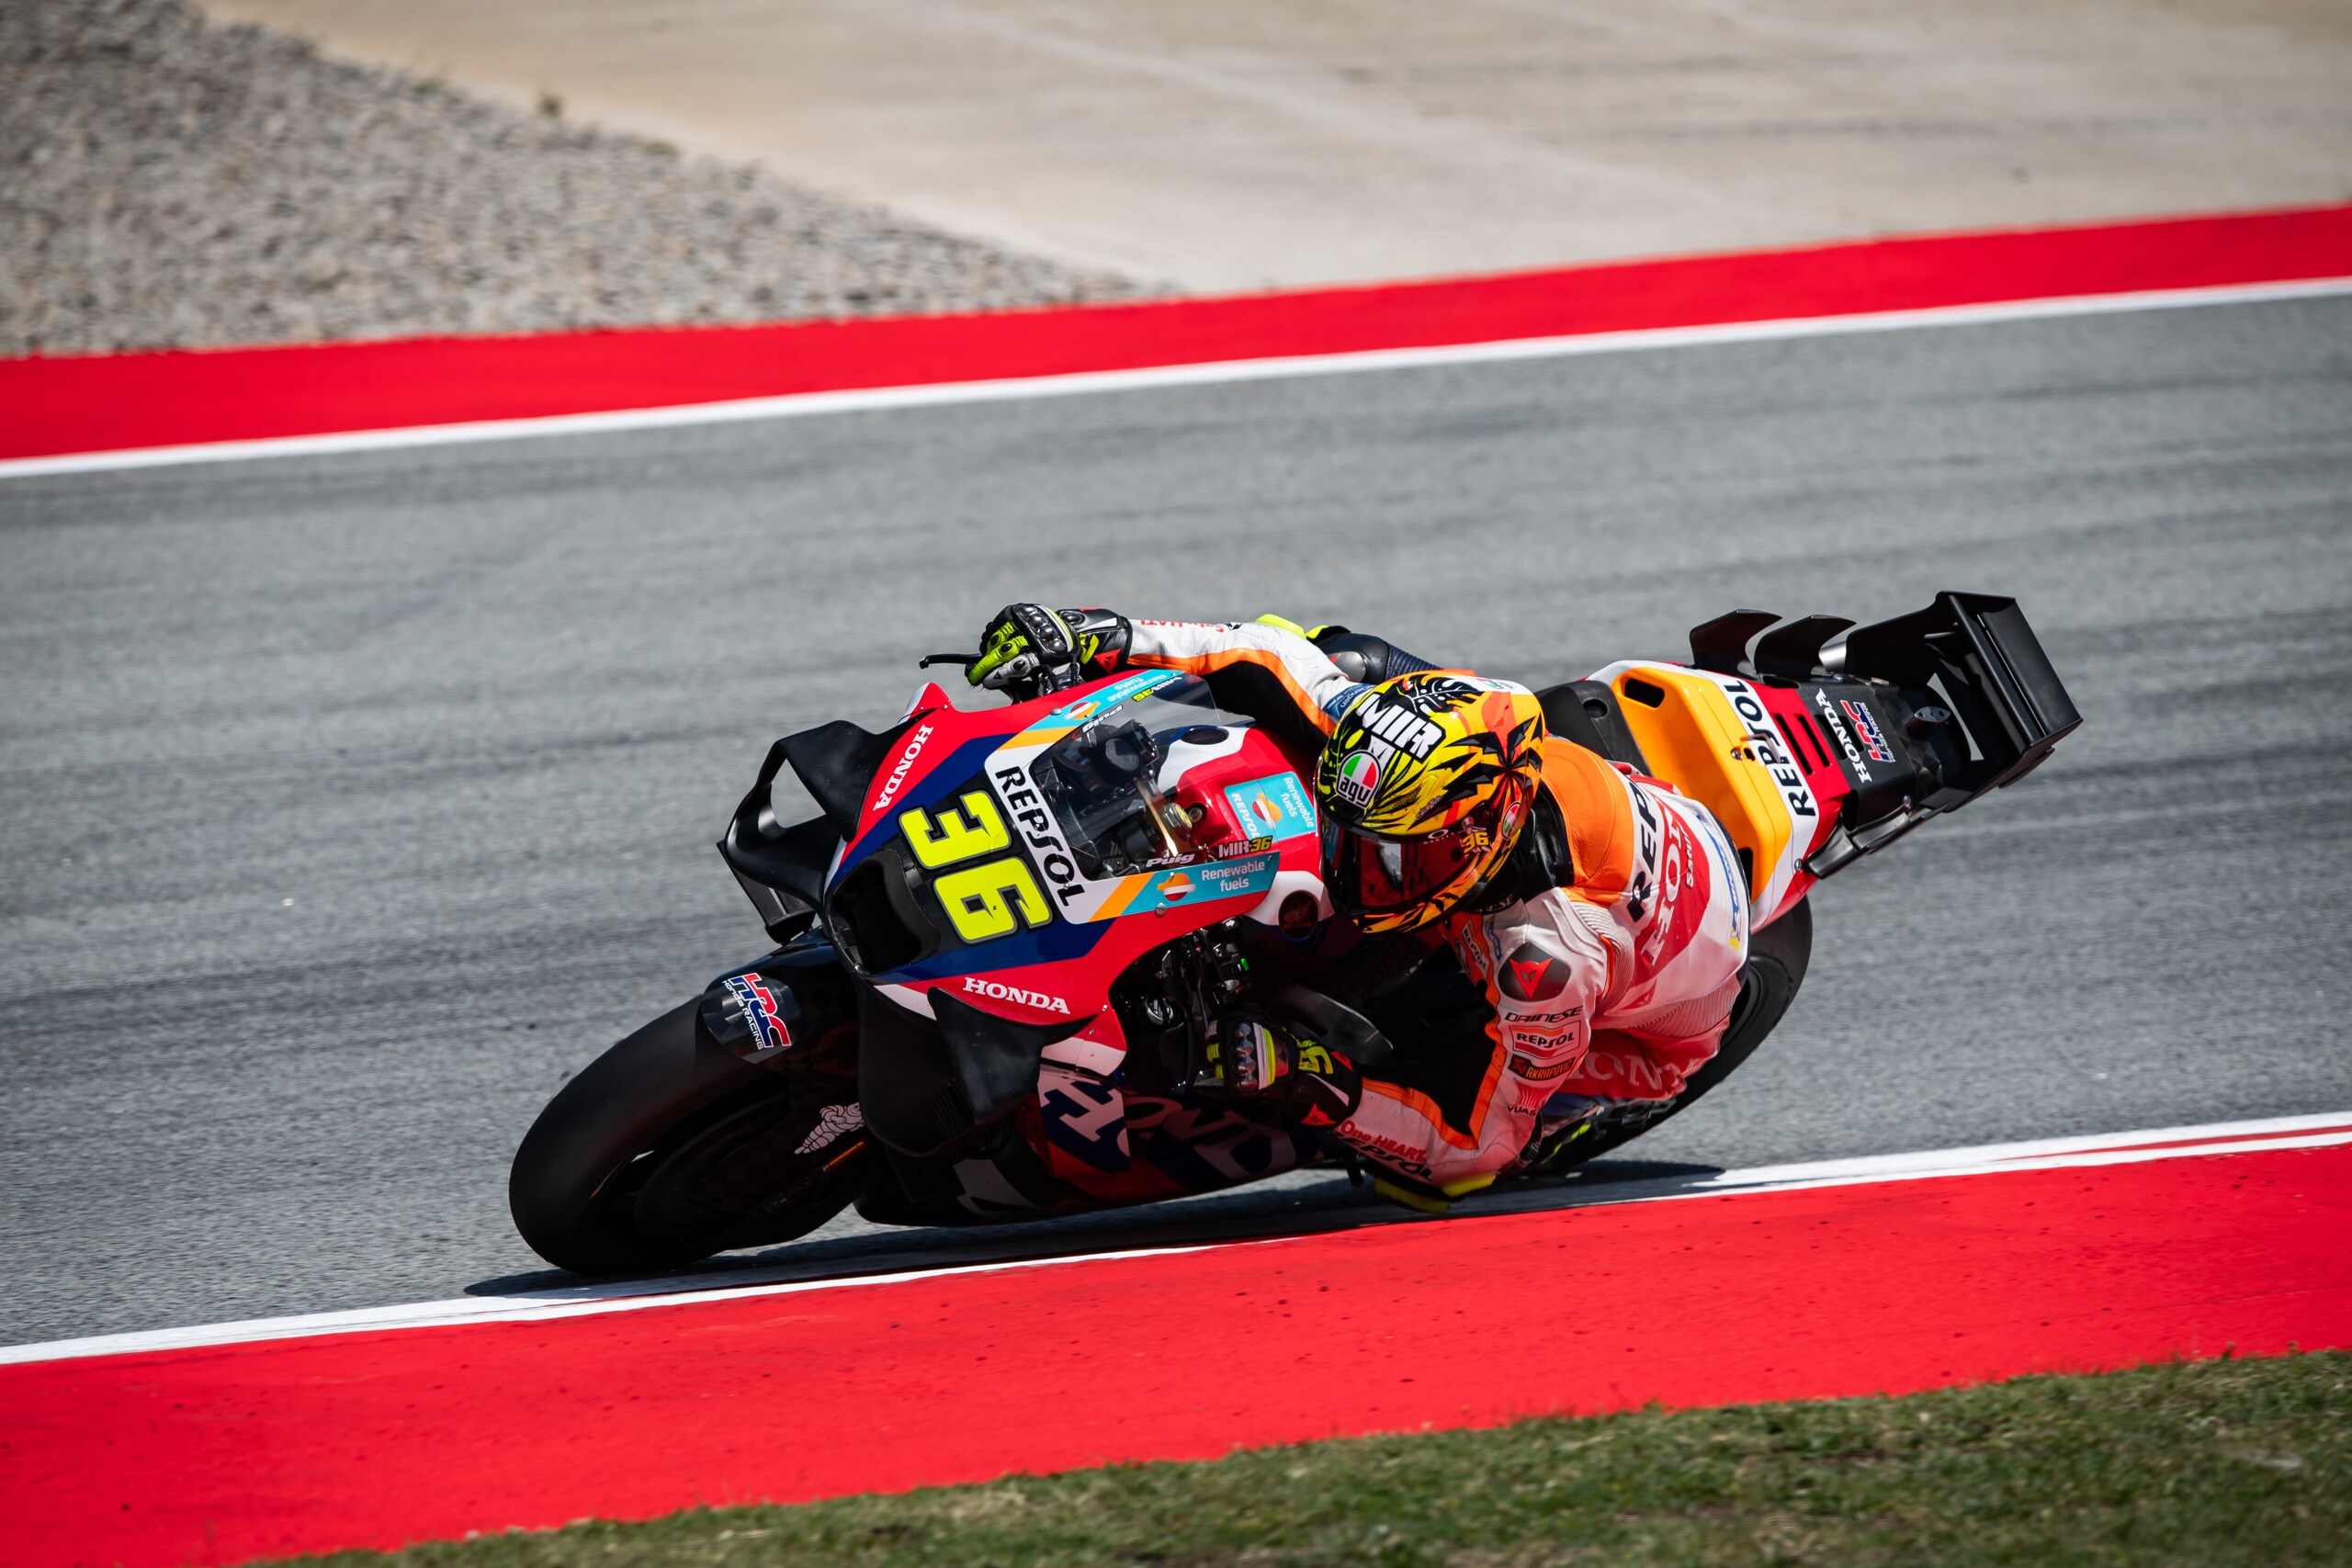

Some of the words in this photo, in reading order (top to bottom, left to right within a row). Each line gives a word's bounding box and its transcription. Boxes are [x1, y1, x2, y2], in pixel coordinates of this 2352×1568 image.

[1354, 693, 1444, 759] MIR
[1724, 680, 1816, 817] REPSOL
[1815, 688, 1872, 784] HONDA
[873, 724, 934, 812] HONDA
[1231, 793, 1261, 840] REPSOL
[1280, 793, 1298, 818] fuels
[1283, 776, 1315, 829] Renewable
[995, 765, 1086, 908] REPSOL
[899, 790, 1054, 944] 36
[1146, 853, 1196, 868] Puig
[1201, 860, 1265, 882] Renewable
[1220, 877, 1250, 893] fuels
[728, 972, 792, 1049] HRC
[963, 976, 1071, 1015] HONDA
[1504, 1005, 1584, 1023] DAINESE
[741, 1007, 764, 1051] RACING
[1516, 1032, 1576, 1049] REPSOL
[1340, 1120, 1373, 1143] One
